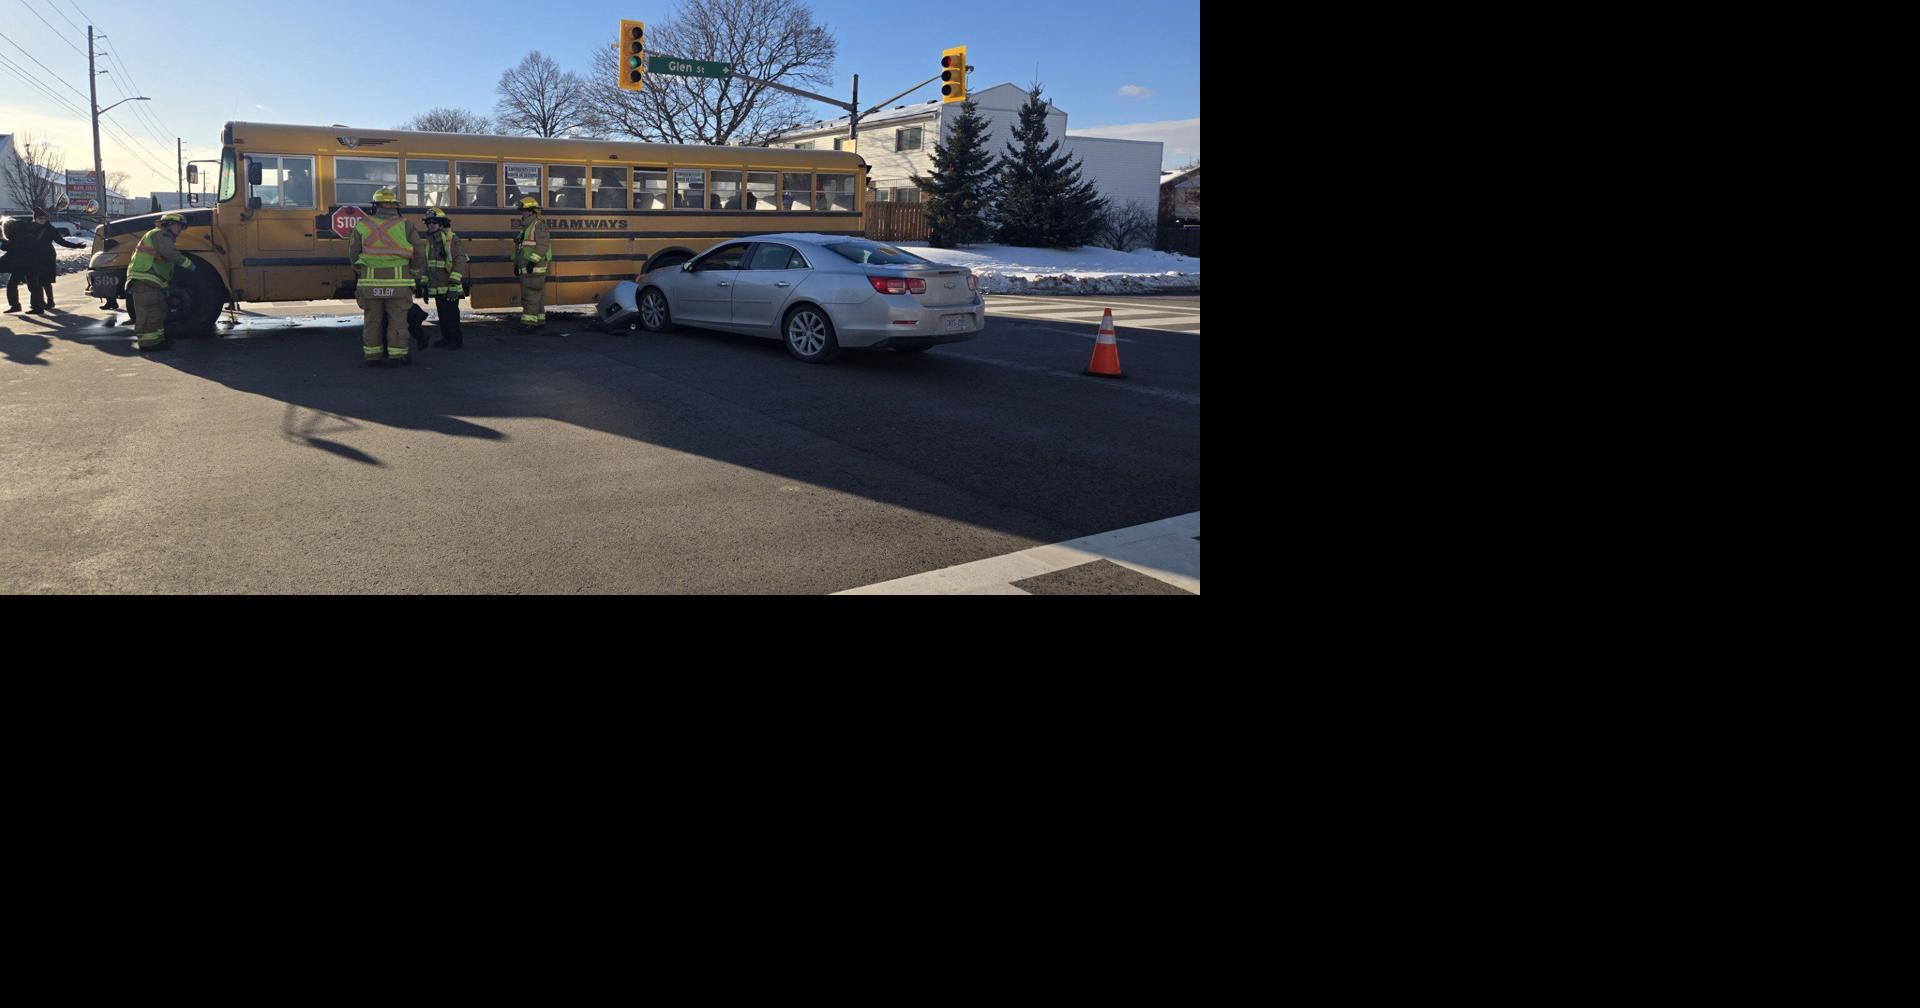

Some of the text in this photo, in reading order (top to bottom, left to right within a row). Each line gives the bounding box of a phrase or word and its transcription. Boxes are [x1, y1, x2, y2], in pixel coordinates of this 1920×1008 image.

[668, 61, 692, 73] Glen
[511, 219, 628, 230] DHAMWAYS
[373, 288, 395, 297] SELBY
